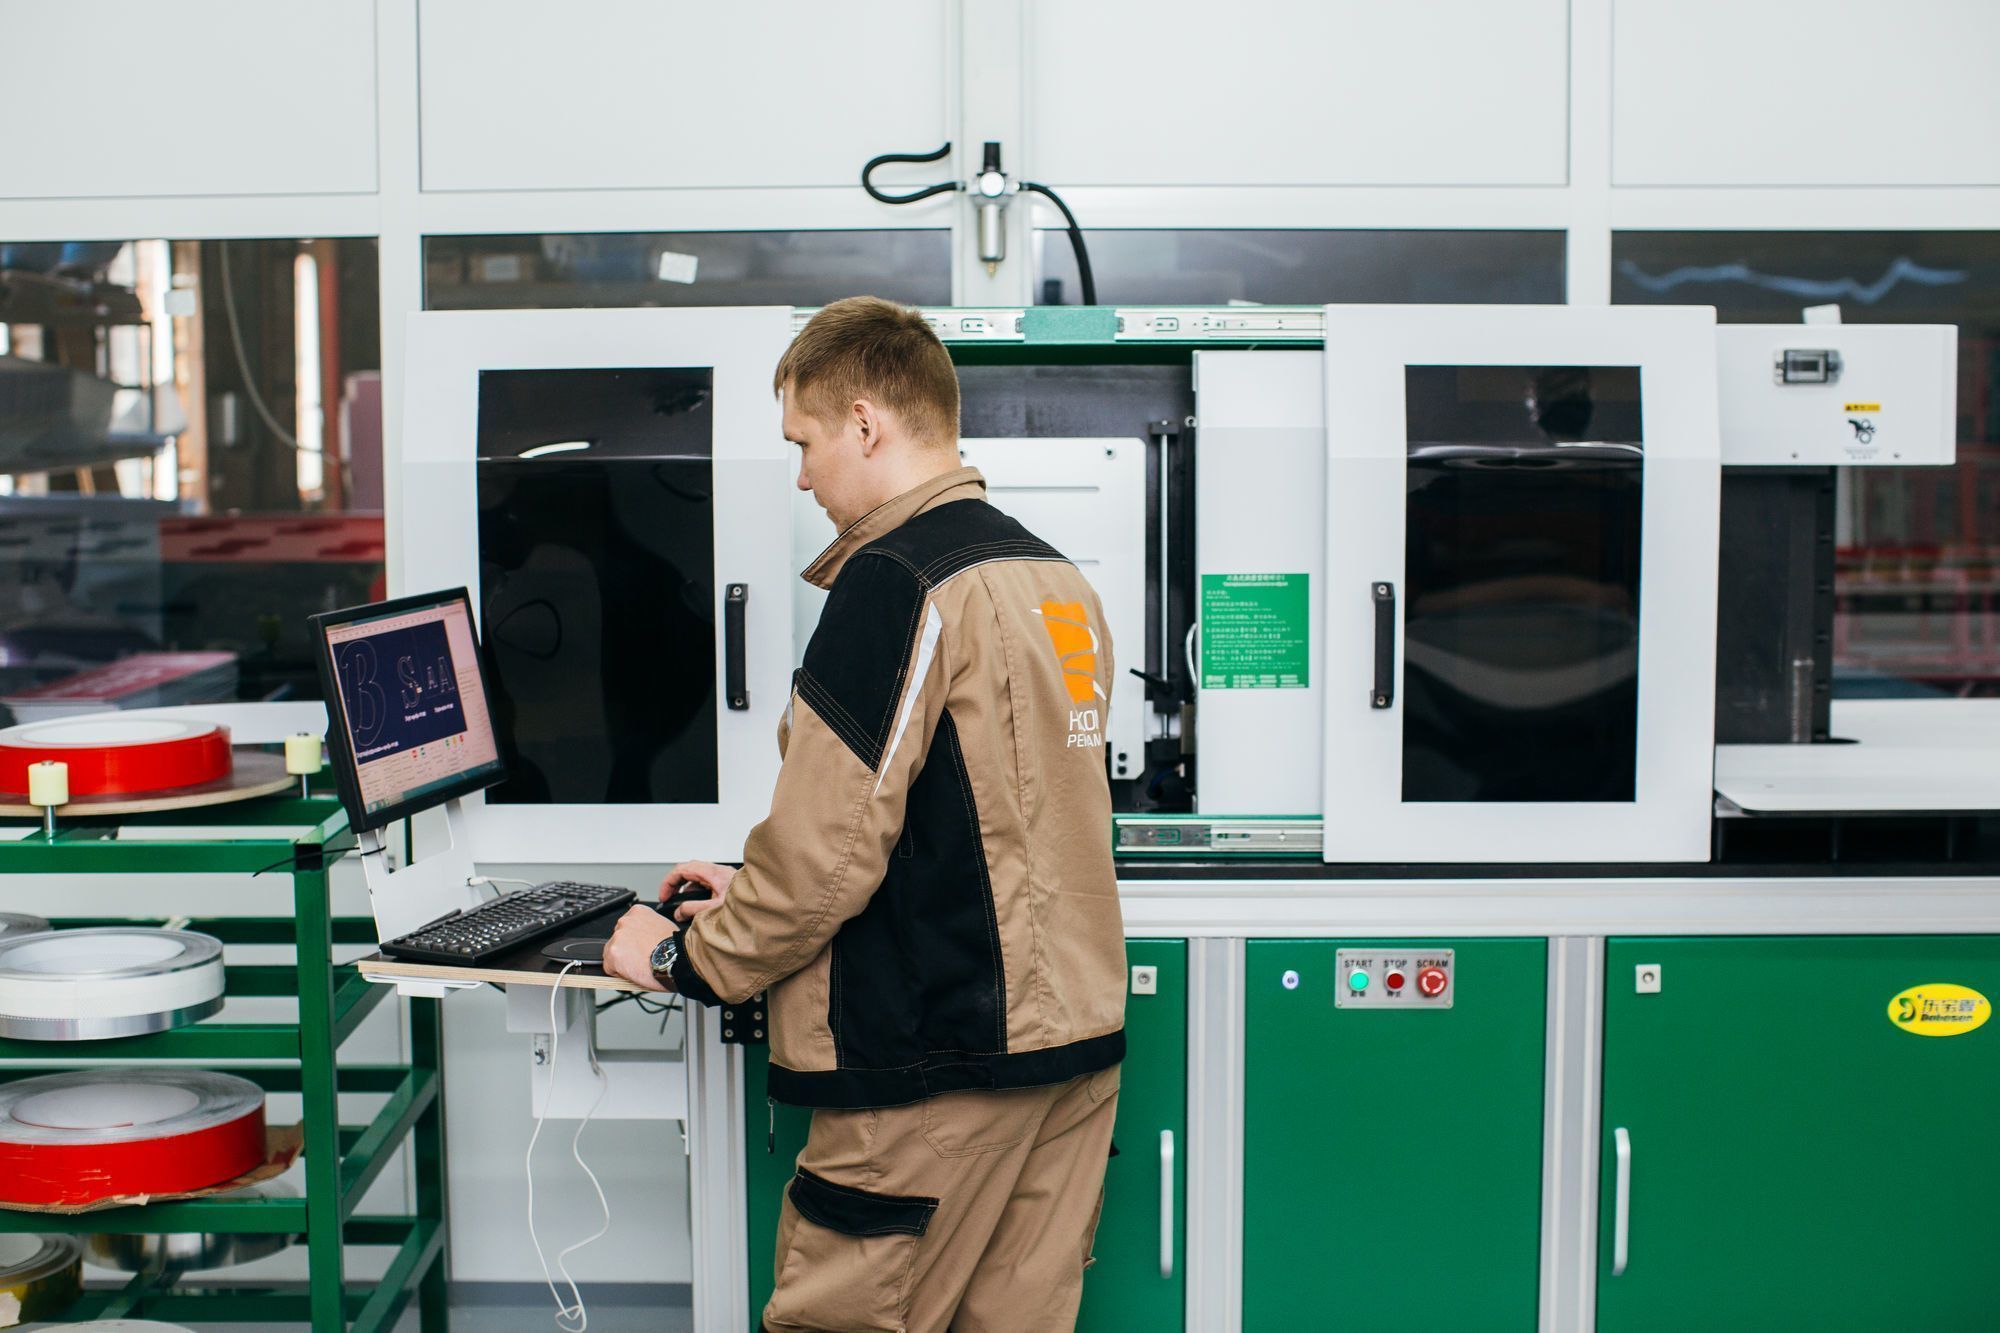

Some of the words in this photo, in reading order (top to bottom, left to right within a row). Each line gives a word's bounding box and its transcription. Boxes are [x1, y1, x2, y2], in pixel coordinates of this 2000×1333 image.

[1344, 959, 1373, 968] START
[1384, 959, 1407, 968] STOP
[1416, 959, 1449, 968] SCRAM
